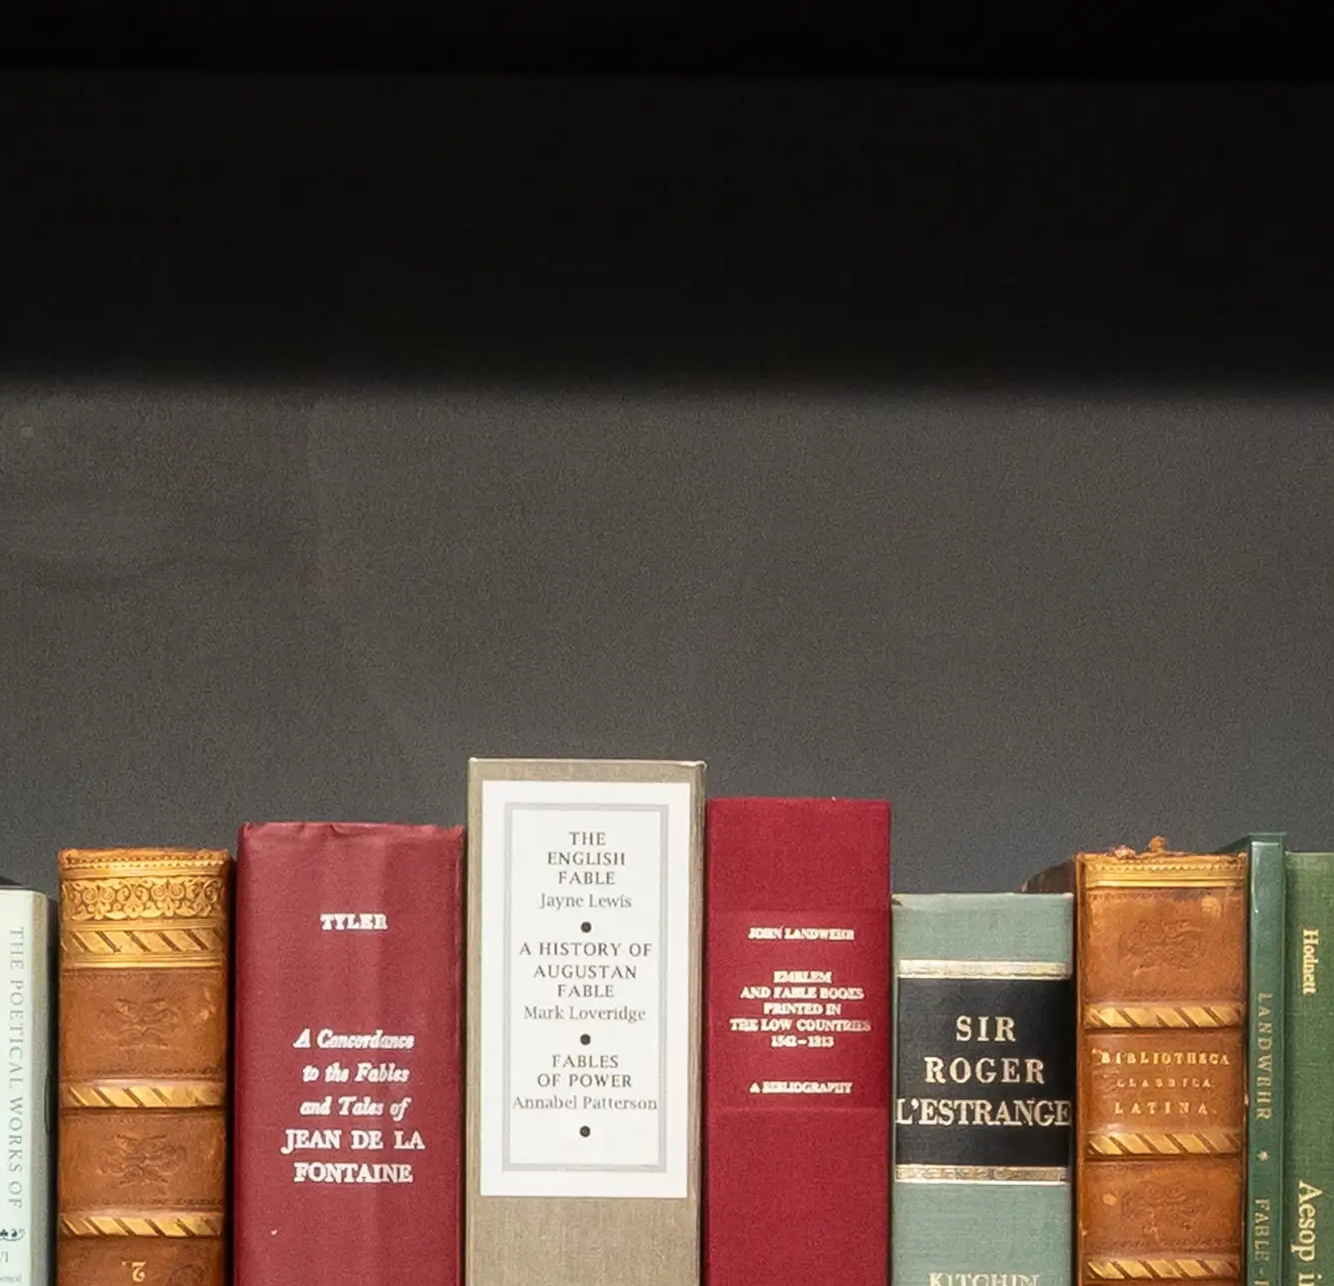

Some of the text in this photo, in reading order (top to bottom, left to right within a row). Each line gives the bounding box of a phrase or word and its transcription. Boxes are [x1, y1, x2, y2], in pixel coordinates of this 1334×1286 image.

[570, 832, 605, 845] THE
[548, 852, 624, 865] ENGLISH
[559, 871, 614, 884] FABLE
[540, 893, 631, 910] Jayne Lewis
[321, 914, 388, 930] TYLER
[520, 942, 651, 957] A HISTORY OF
[1303, 929, 1319, 994] Hodnett
[534, 965, 636, 978] AUGUSTAN
[558, 984, 613, 997] FABLE
[525, 1005, 645, 1023] Mark Loveridge
[956, 1016, 1015, 1041] SIR
[293, 1029, 414, 1048] A Concordance
[9, 927, 24, 1208] THE POETICAL WORKS OF
[553, 1055, 618, 1068] FABLES
[924, 1057, 1043, 1083] ROGER
[325, 1062, 349, 1082] the
[355, 1063, 409, 1082] Fables
[538, 1074, 631, 1087] OF POWER
[300, 1096, 411, 1121] and Tales of
[514, 1095, 657, 1109] Annabel Patterson
[894, 1098, 1070, 1126] L'ESTRANGE
[281, 1129, 425, 1154] JEAN DE LA
[294, 1163, 413, 1183] FONTAINE
[1291, 1180, 1322, 1261] Aesop
